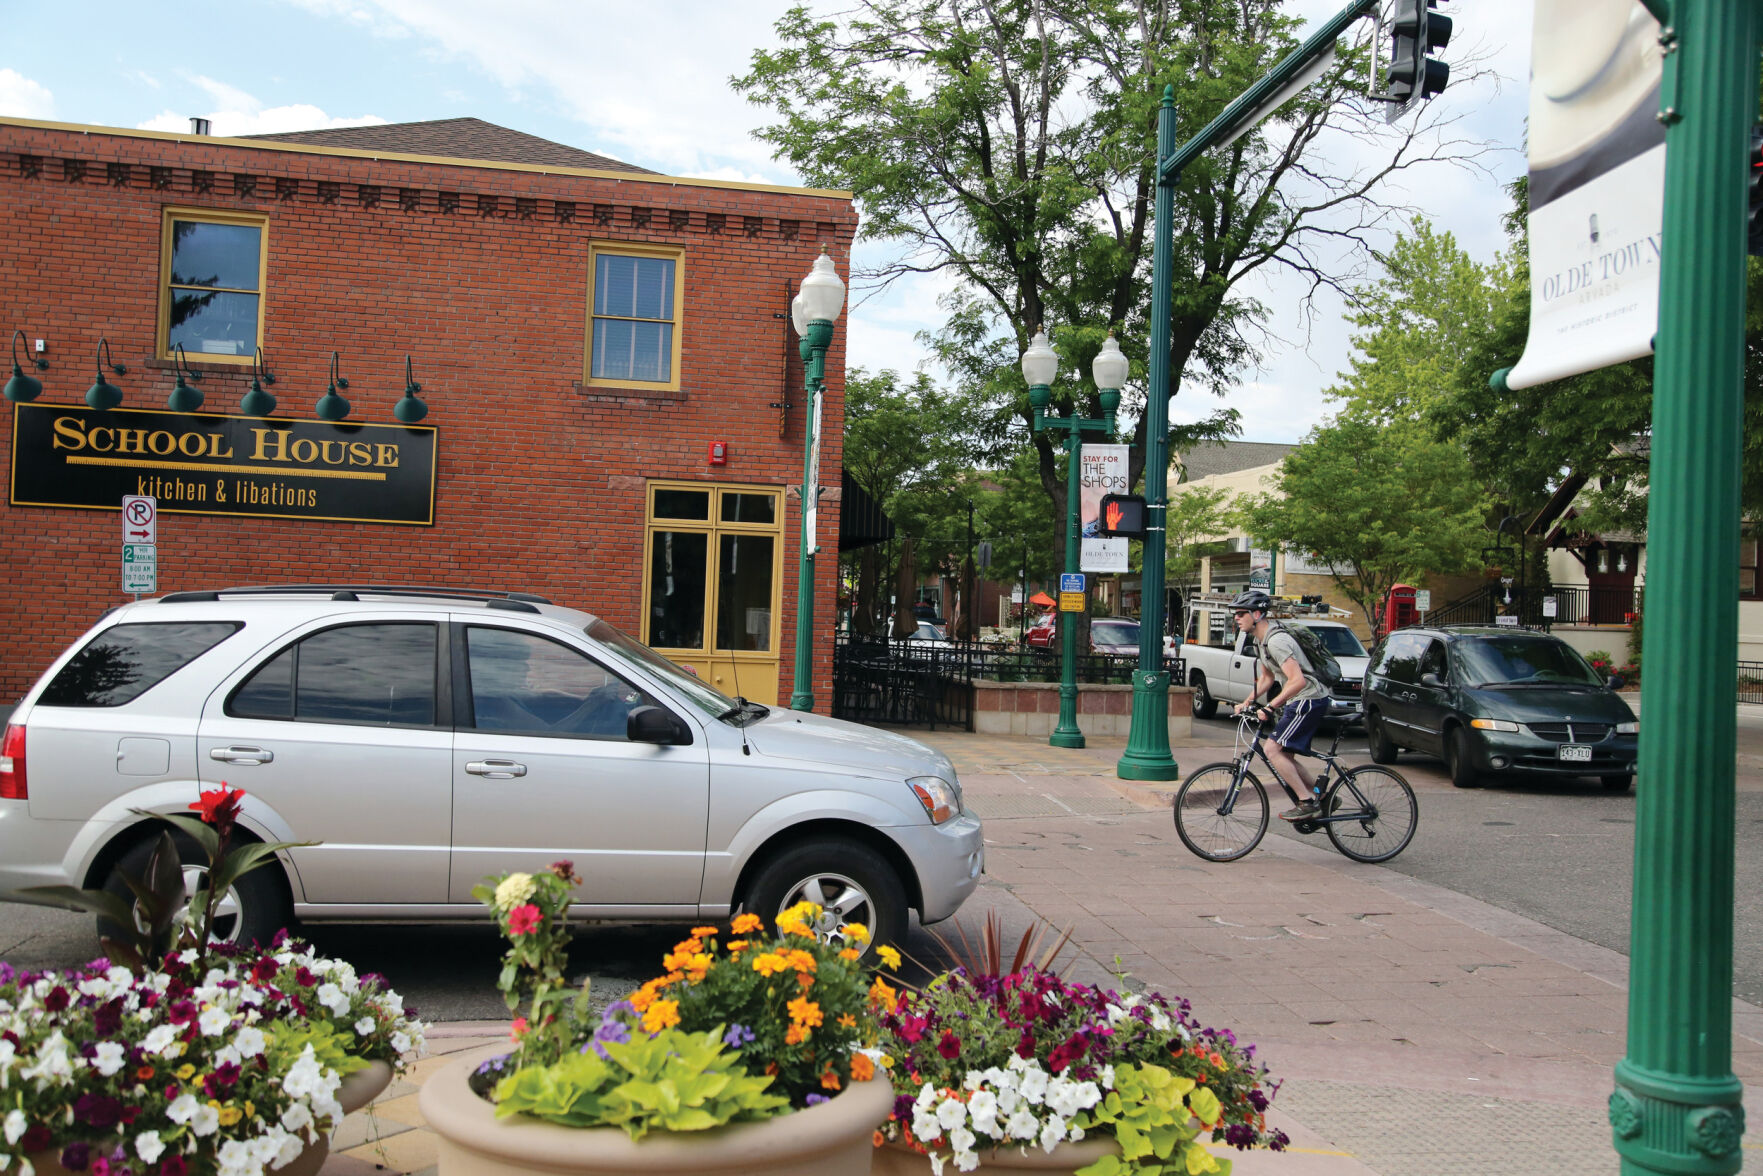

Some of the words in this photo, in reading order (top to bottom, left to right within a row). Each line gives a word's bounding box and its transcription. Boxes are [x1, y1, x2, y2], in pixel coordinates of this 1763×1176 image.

[1543, 261, 1593, 302] OLDE
[53, 416, 234, 459] SCHOOL
[249, 428, 399, 468] HOUSE
[1083, 463, 1105, 474] THE
[137, 475, 206, 501] kitchen
[215, 479, 226, 502] &
[236, 480, 317, 507] libations
[1084, 476, 1127, 488] SHOPS
[125, 547, 133, 560] 2
